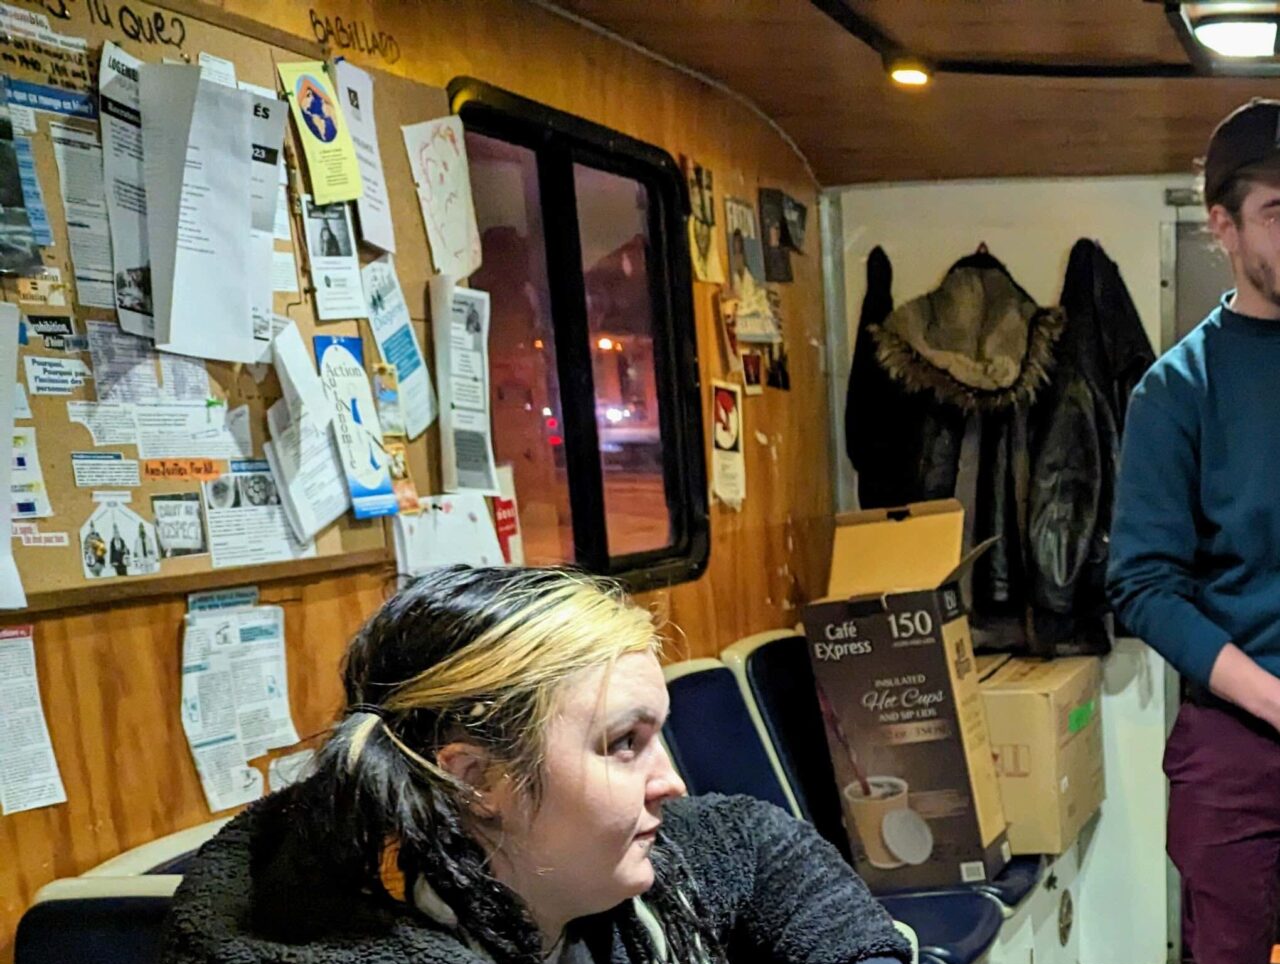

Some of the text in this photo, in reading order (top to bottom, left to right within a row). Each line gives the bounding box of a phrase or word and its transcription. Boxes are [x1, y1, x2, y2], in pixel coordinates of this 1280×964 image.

[325, 362, 363, 379] Action
[825, 621, 858, 641] Café
[888, 610, 933, 639] 150
[874, 674, 926, 688] INSULATED
[860, 687, 944, 712] Hot Cups
[879, 712, 899, 722] AND
